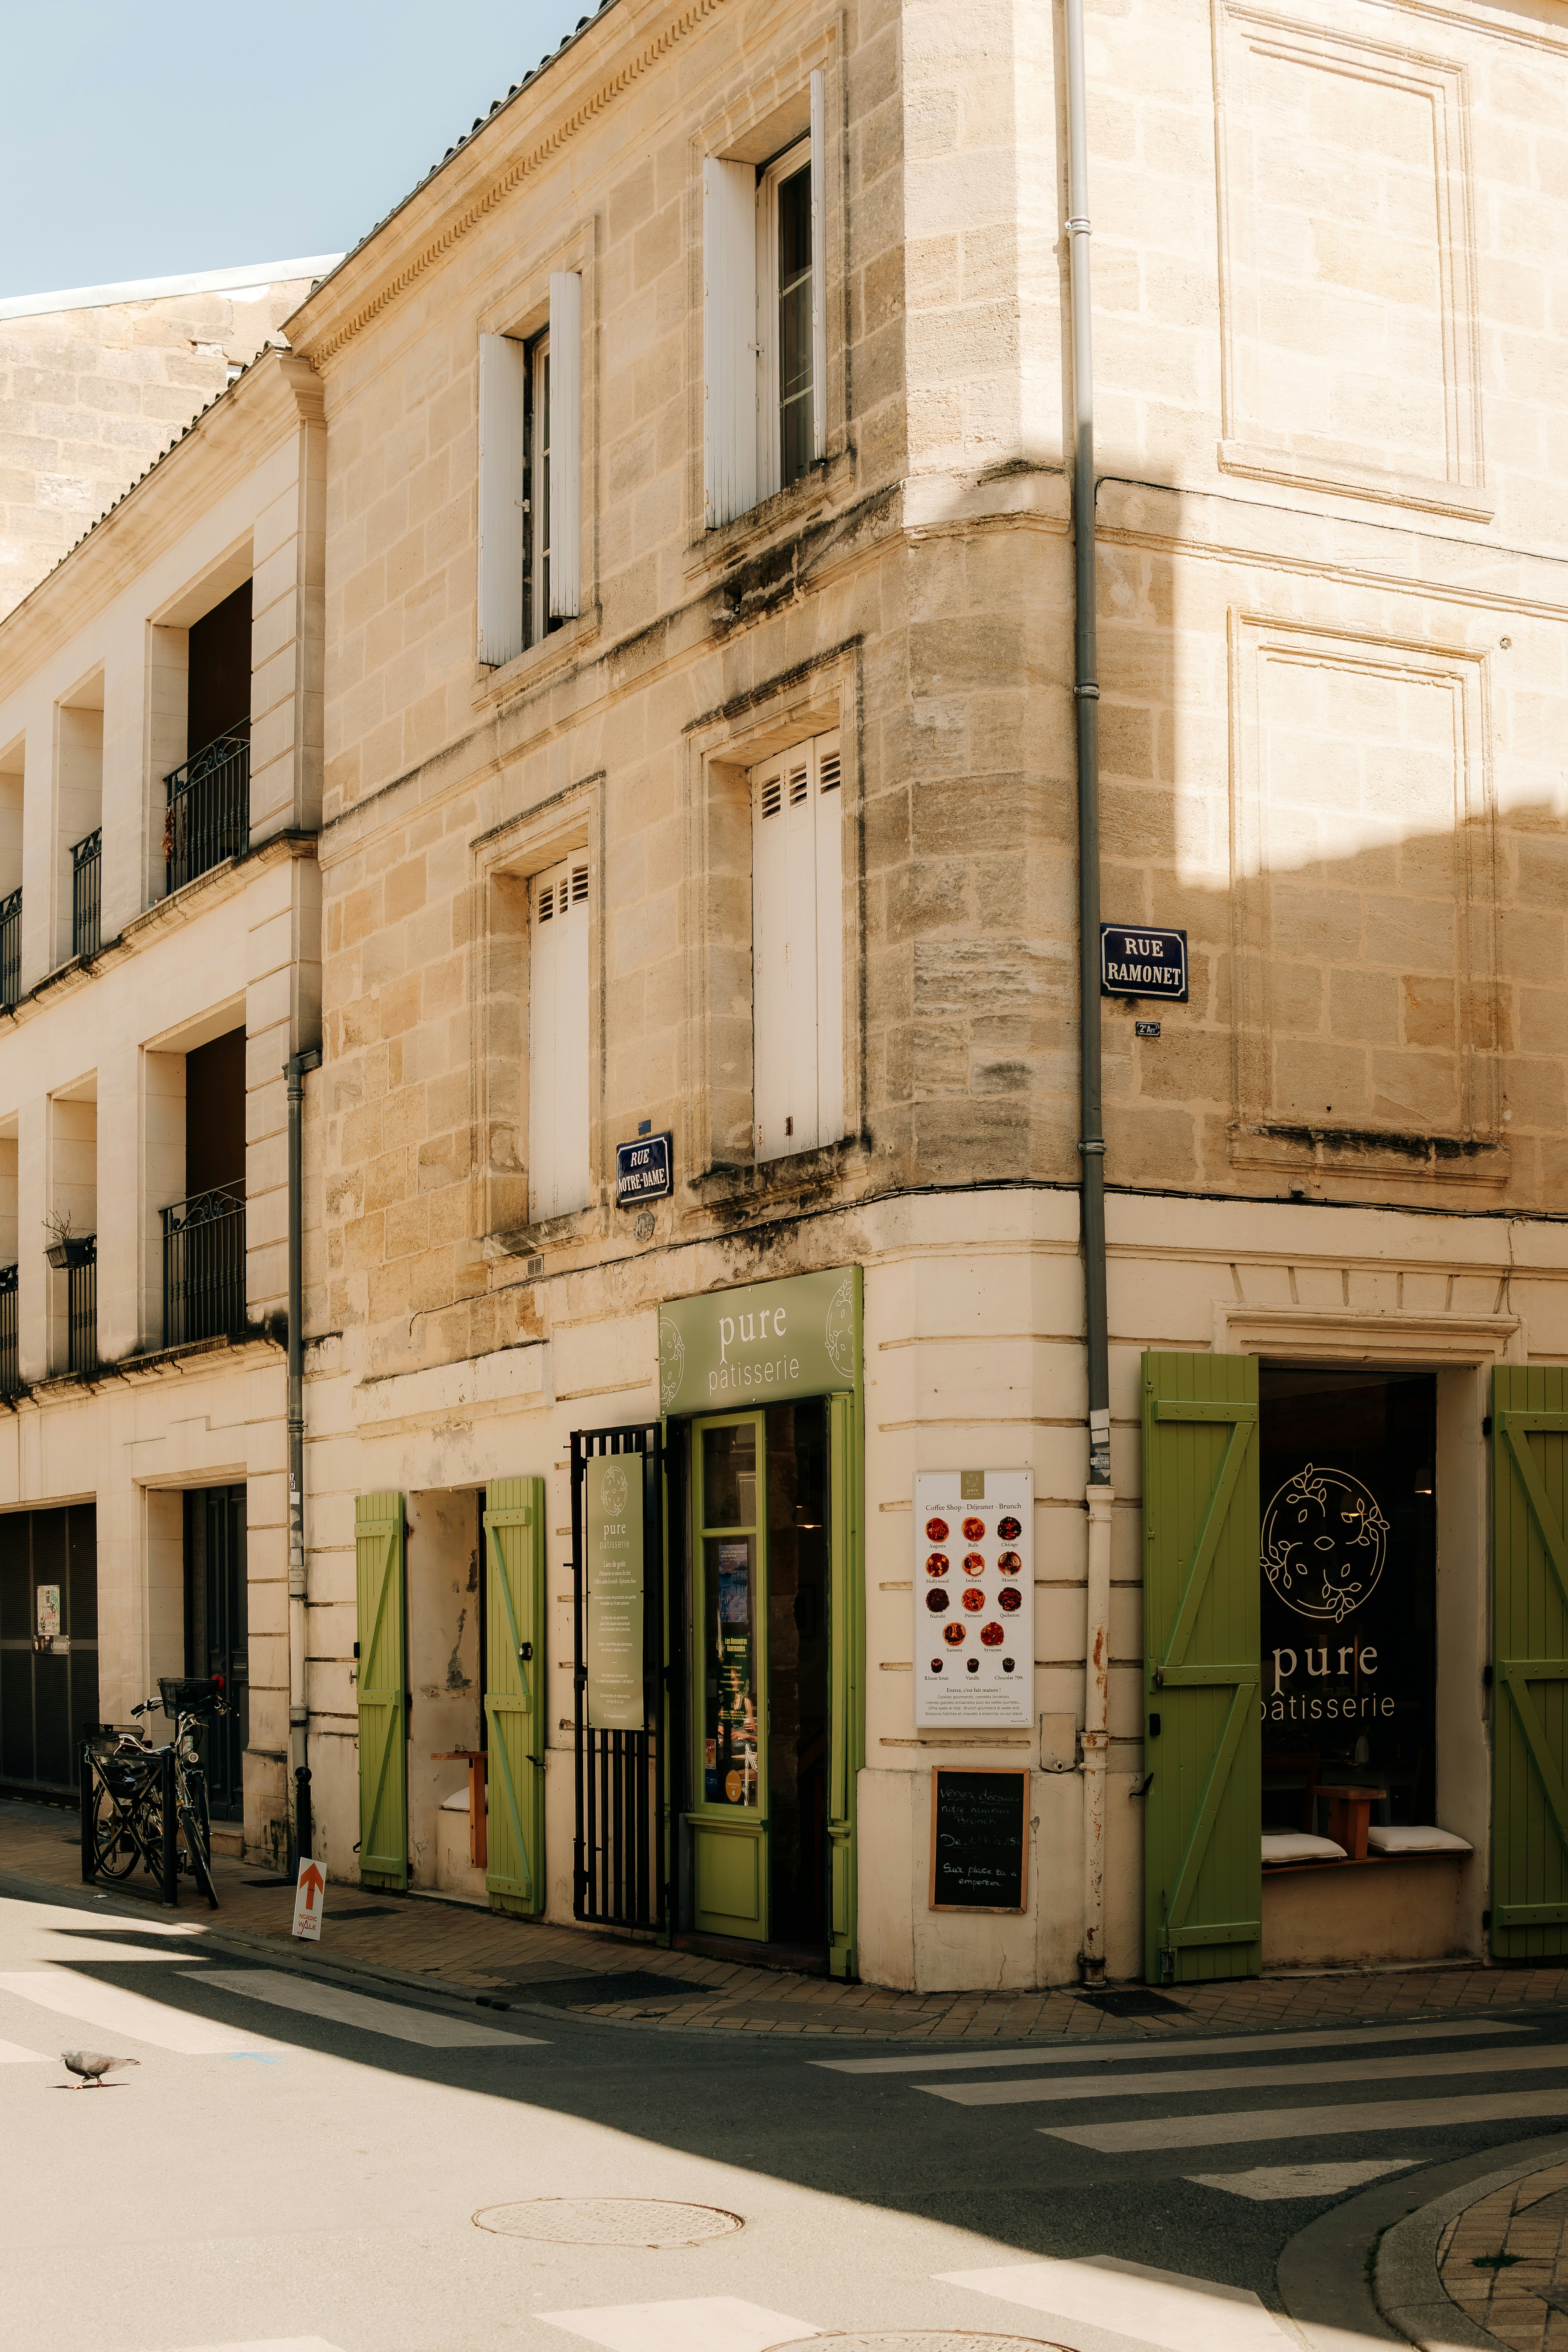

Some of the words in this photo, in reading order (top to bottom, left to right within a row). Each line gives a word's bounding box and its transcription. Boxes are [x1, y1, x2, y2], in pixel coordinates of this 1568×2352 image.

[1125, 938, 1163, 957] RUE
[1108, 963, 1181, 985] RAMONET
[630, 1149, 649, 1167] RUE
[618, 1168, 665, 1193] NOTRE-DAME
[719, 1307, 786, 1366] pure
[604, 1524, 626, 1542] pure
[617, 1561, 626, 1569] goût
[1271, 1646, 1378, 1696] pure
[941, 1782, 976, 1804] Venez
[940, 1834, 962, 1846] De
[994, 1836, 1000, 1845] à
[1004, 1837, 1021, 1846] 15h
[944, 1863, 964, 1873] Sur
[969, 1866, 993, 1877] place
[959, 1878, 1002, 1890] emporter
[299, 1913, 317, 1922] NORDIC
[299, 1920, 316, 1935] WALK
